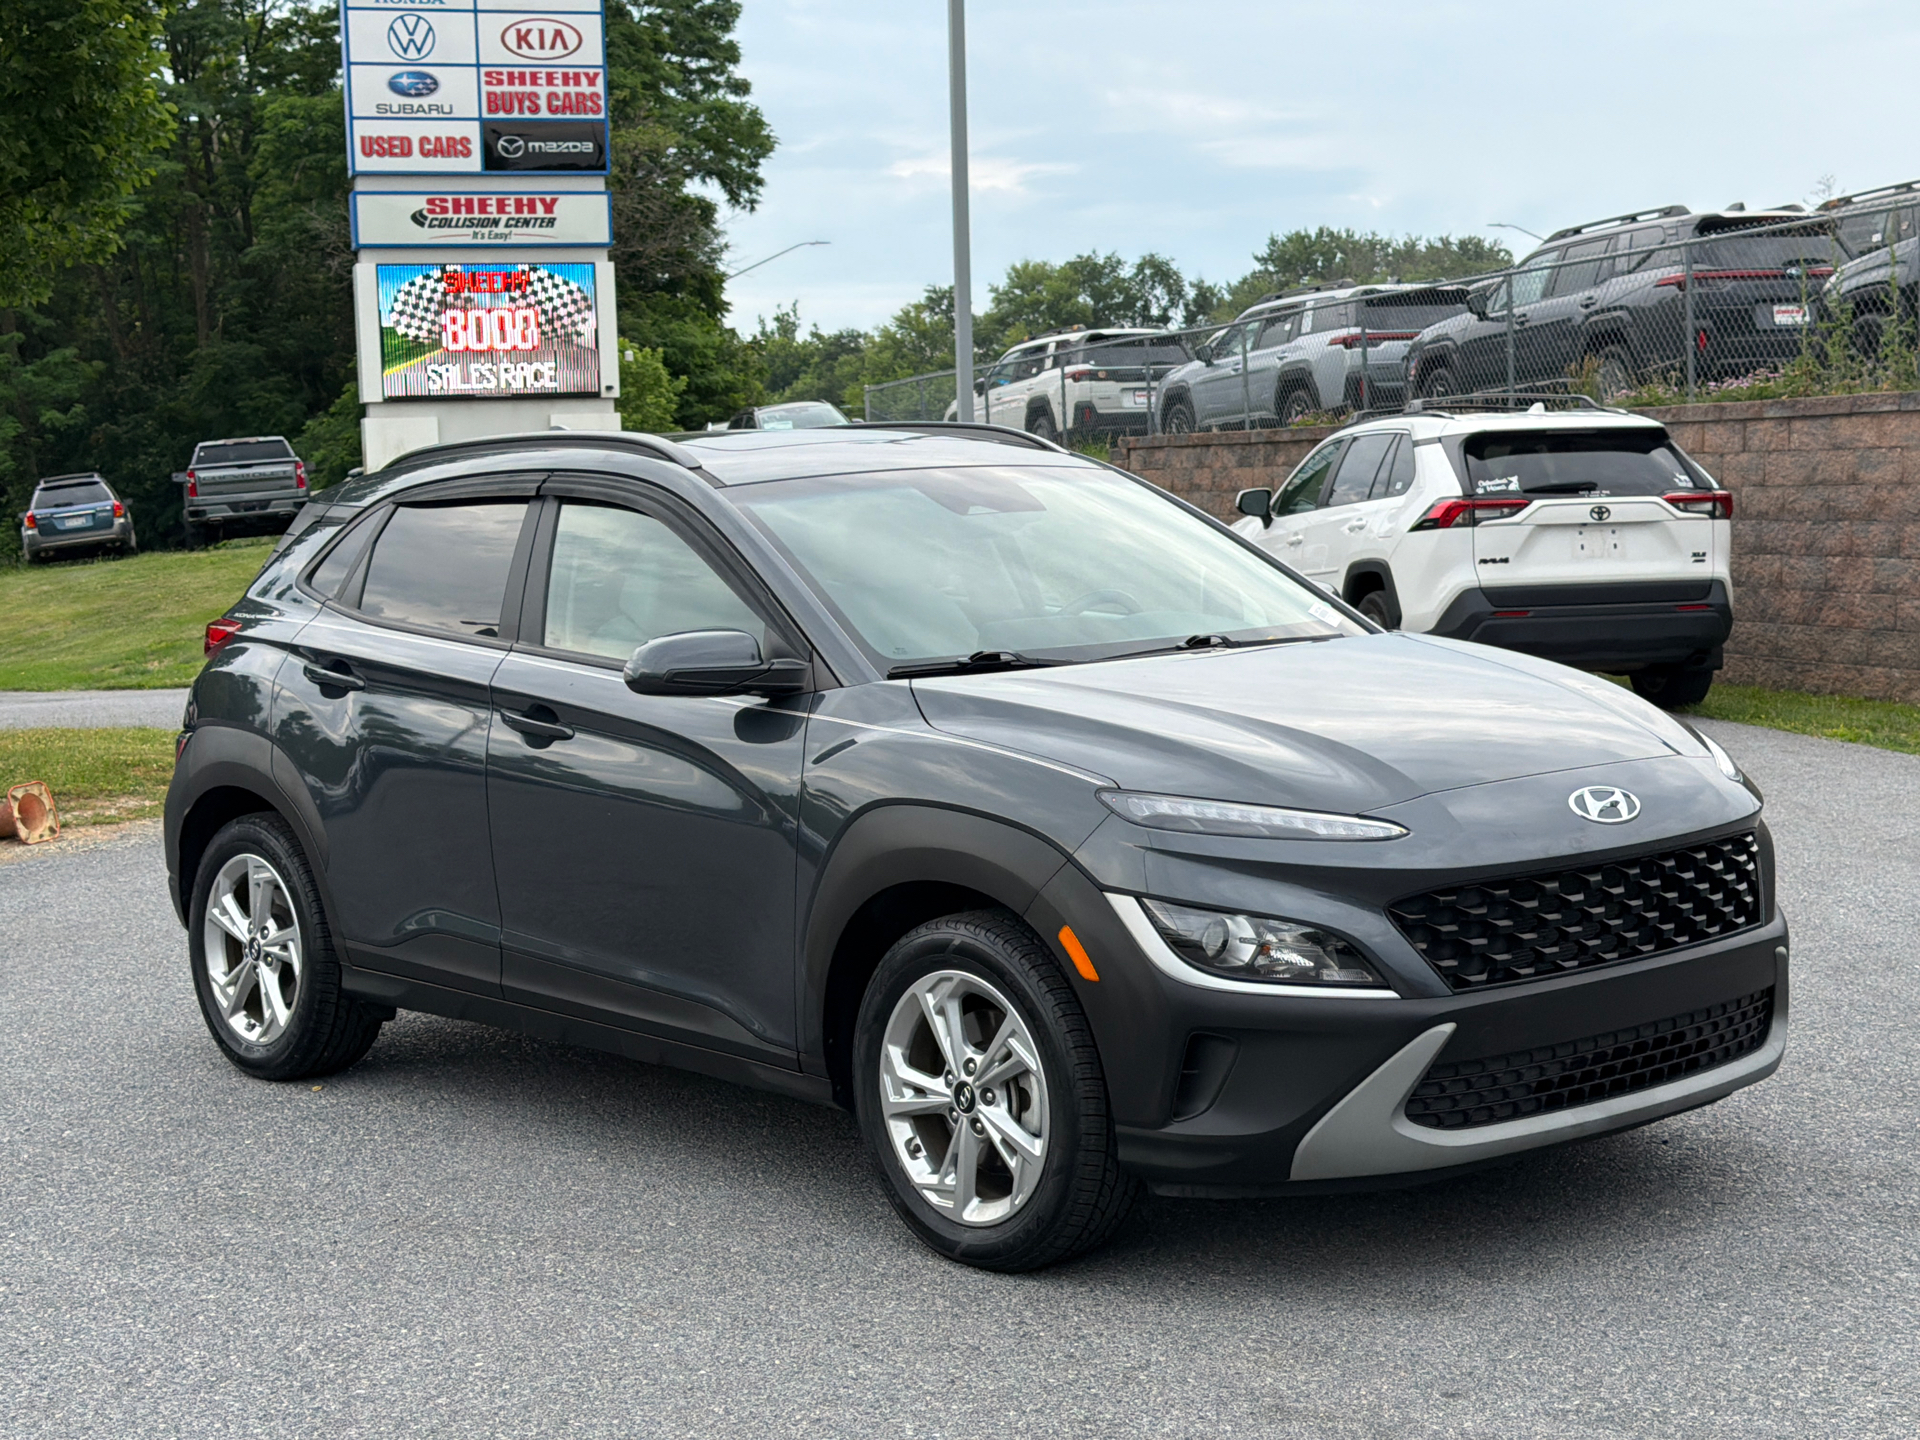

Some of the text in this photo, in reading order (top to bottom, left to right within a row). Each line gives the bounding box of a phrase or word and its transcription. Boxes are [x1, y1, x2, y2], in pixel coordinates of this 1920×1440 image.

[516, 28, 569, 50] KIA
[484, 71, 600, 87] SHEEHY
[376, 104, 453, 115] SUBARU
[486, 91, 602, 115] BUYS CARS
[360, 136, 472, 158] USED CARS
[426, 197, 559, 215] SHEEHY
[427, 217, 557, 229] COLLISION CENTER
[472, 230, 513, 241] It's Easy!
[426, 362, 557, 390] SALES RACE
